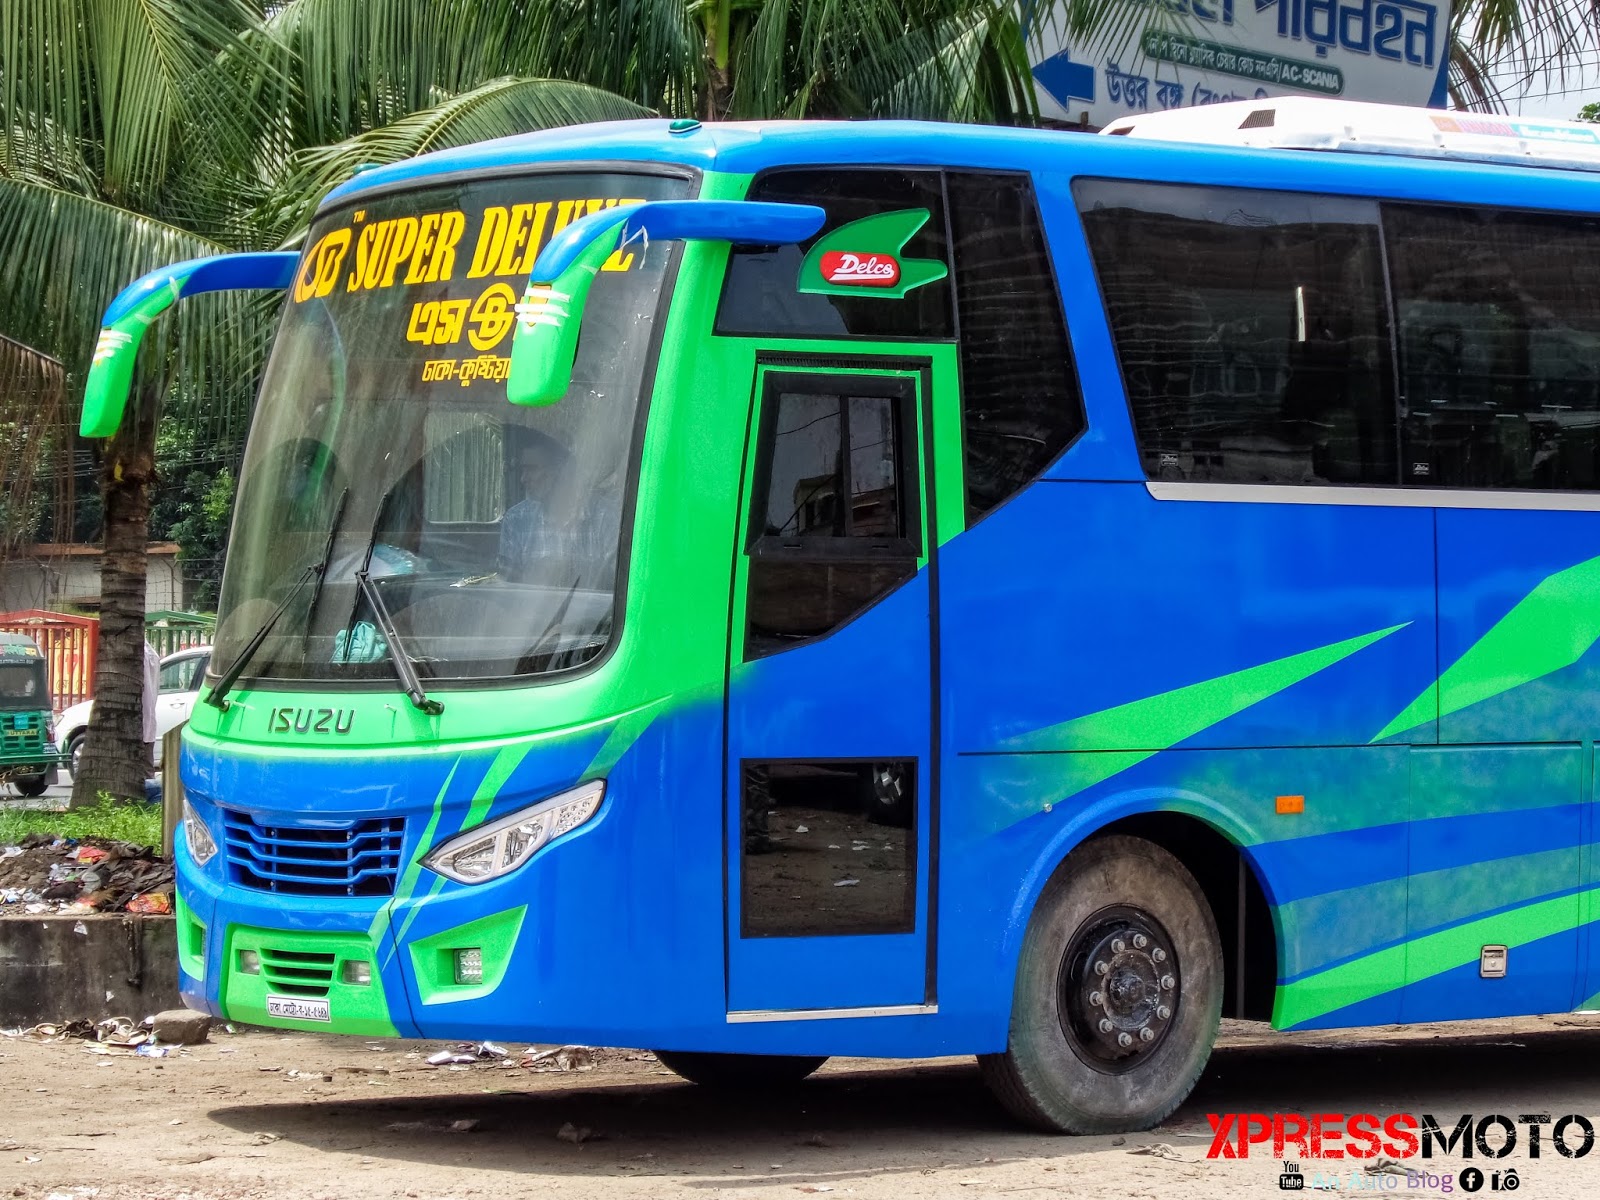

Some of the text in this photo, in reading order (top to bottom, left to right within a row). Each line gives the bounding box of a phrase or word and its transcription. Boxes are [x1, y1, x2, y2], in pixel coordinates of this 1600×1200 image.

[347, 210, 465, 293] SUPER
[829, 253, 895, 281] Delco
[268, 707, 355, 735] ISUZU
